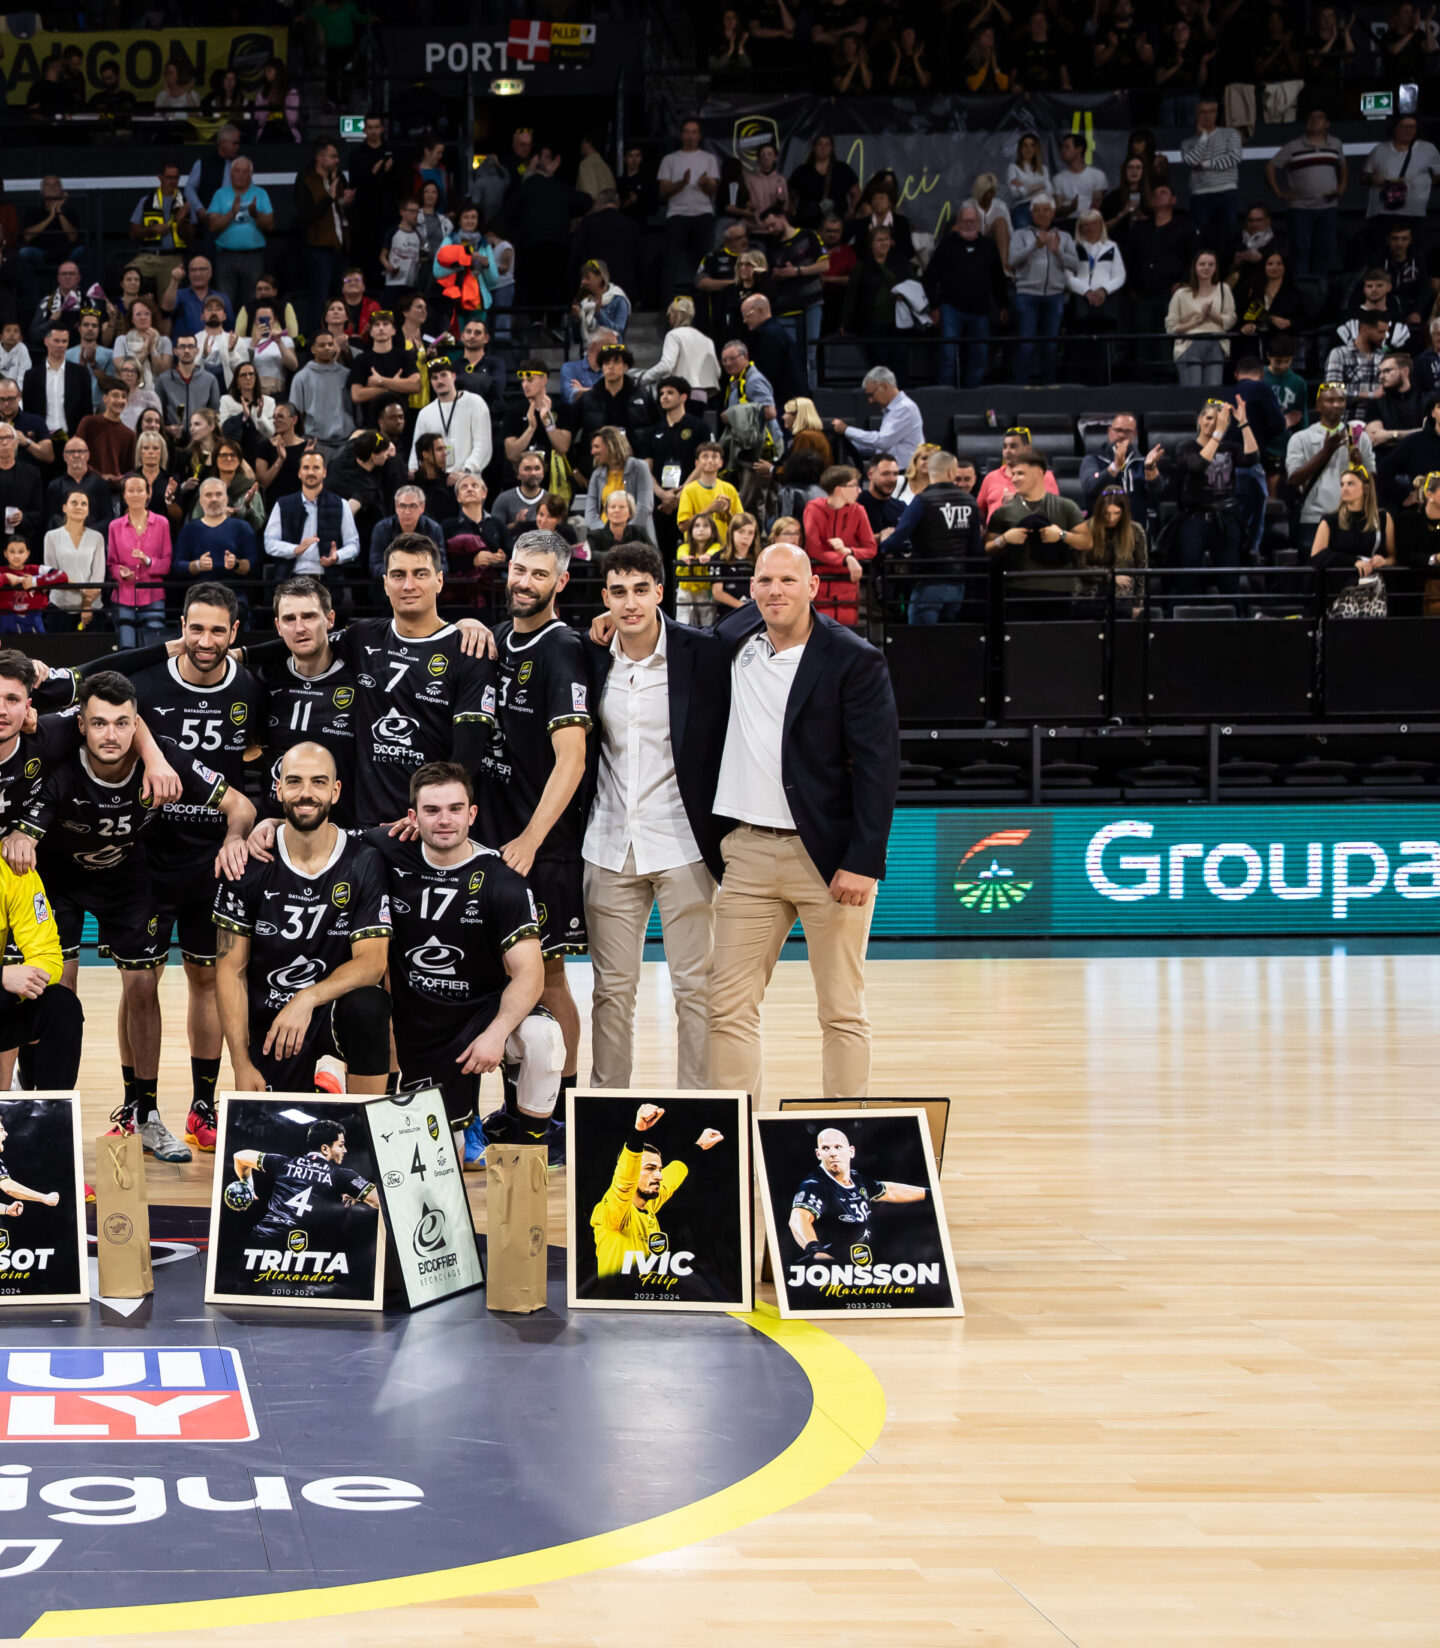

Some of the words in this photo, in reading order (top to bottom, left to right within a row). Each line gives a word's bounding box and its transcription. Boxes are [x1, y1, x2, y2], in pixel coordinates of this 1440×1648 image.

[939, 503, 972, 529] VIP
[384, 661, 409, 693] 7
[415, 693, 449, 706] Groupama
[290, 700, 312, 731] 11
[179, 719, 223, 751] 55
[163, 803, 224, 815] EXCOFFIE
[97, 814, 132, 836] 25
[1085, 820, 1440, 919] Groupa
[420, 887, 458, 921] 17
[280, 904, 328, 940] 37
[410, 1141, 427, 1182] 4
[287, 1164, 333, 1186] TRITTA
[284, 1186, 313, 1217] 4
[244, 1249, 349, 1274] TRITTA
[418, 1252, 457, 1275] EXCOFFIER
[621, 1250, 695, 1276] IVIC
[253, 1269, 335, 1283] Alexandre
[638, 1271, 679, 1291] Filip
[788, 1263, 940, 1287] JONSSON
[272, 1288, 315, 1296] 2010-2024
[634, 1292, 680, 1300] 2022-2024
